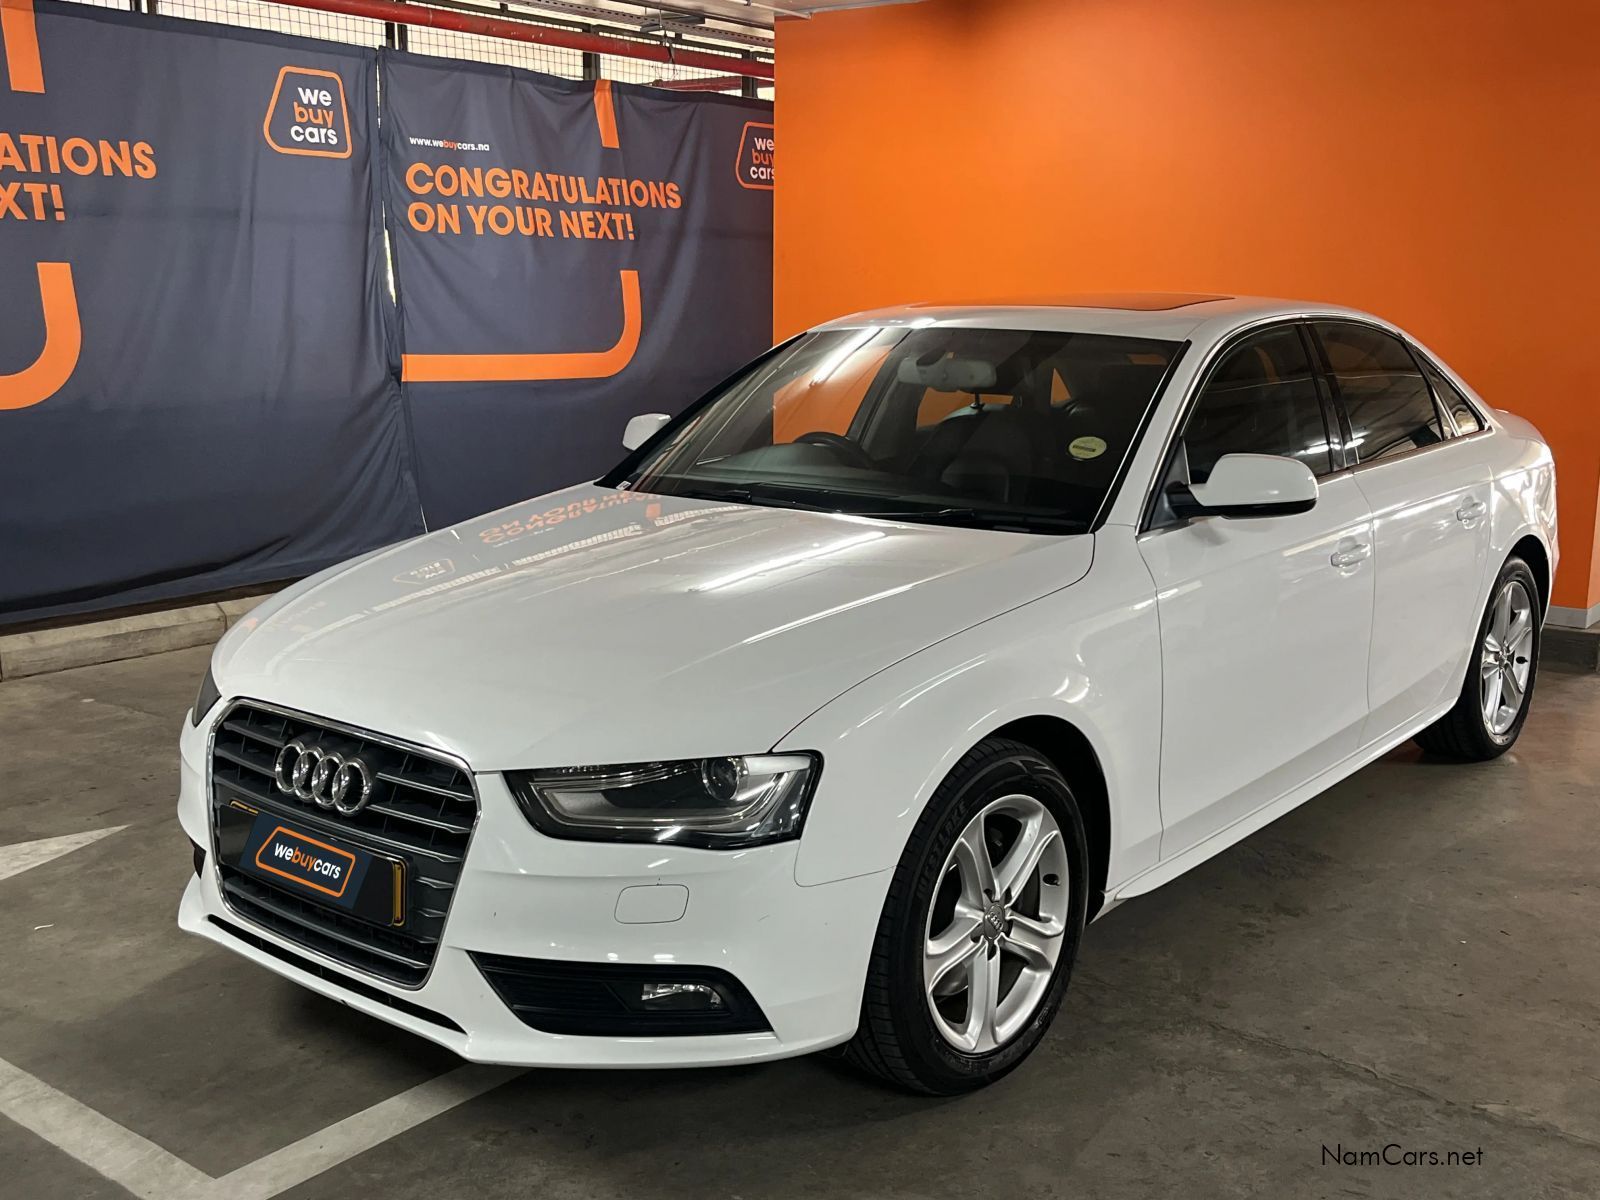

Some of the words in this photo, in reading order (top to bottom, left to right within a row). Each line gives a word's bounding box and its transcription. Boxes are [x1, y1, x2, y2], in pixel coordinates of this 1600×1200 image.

[297, 87, 332, 106] we
[293, 101, 334, 128] buy
[290, 125, 338, 145] cars
[409, 136, 490, 151] www.webuycars.na
[754, 137, 775, 151] we
[0, 132, 157, 179] ATIONS
[405, 162, 682, 209] CONGRATULATIONS
[407, 202, 460, 234] ON
[466, 205, 554, 237] YOUR
[560, 211, 634, 241] NEXT!
